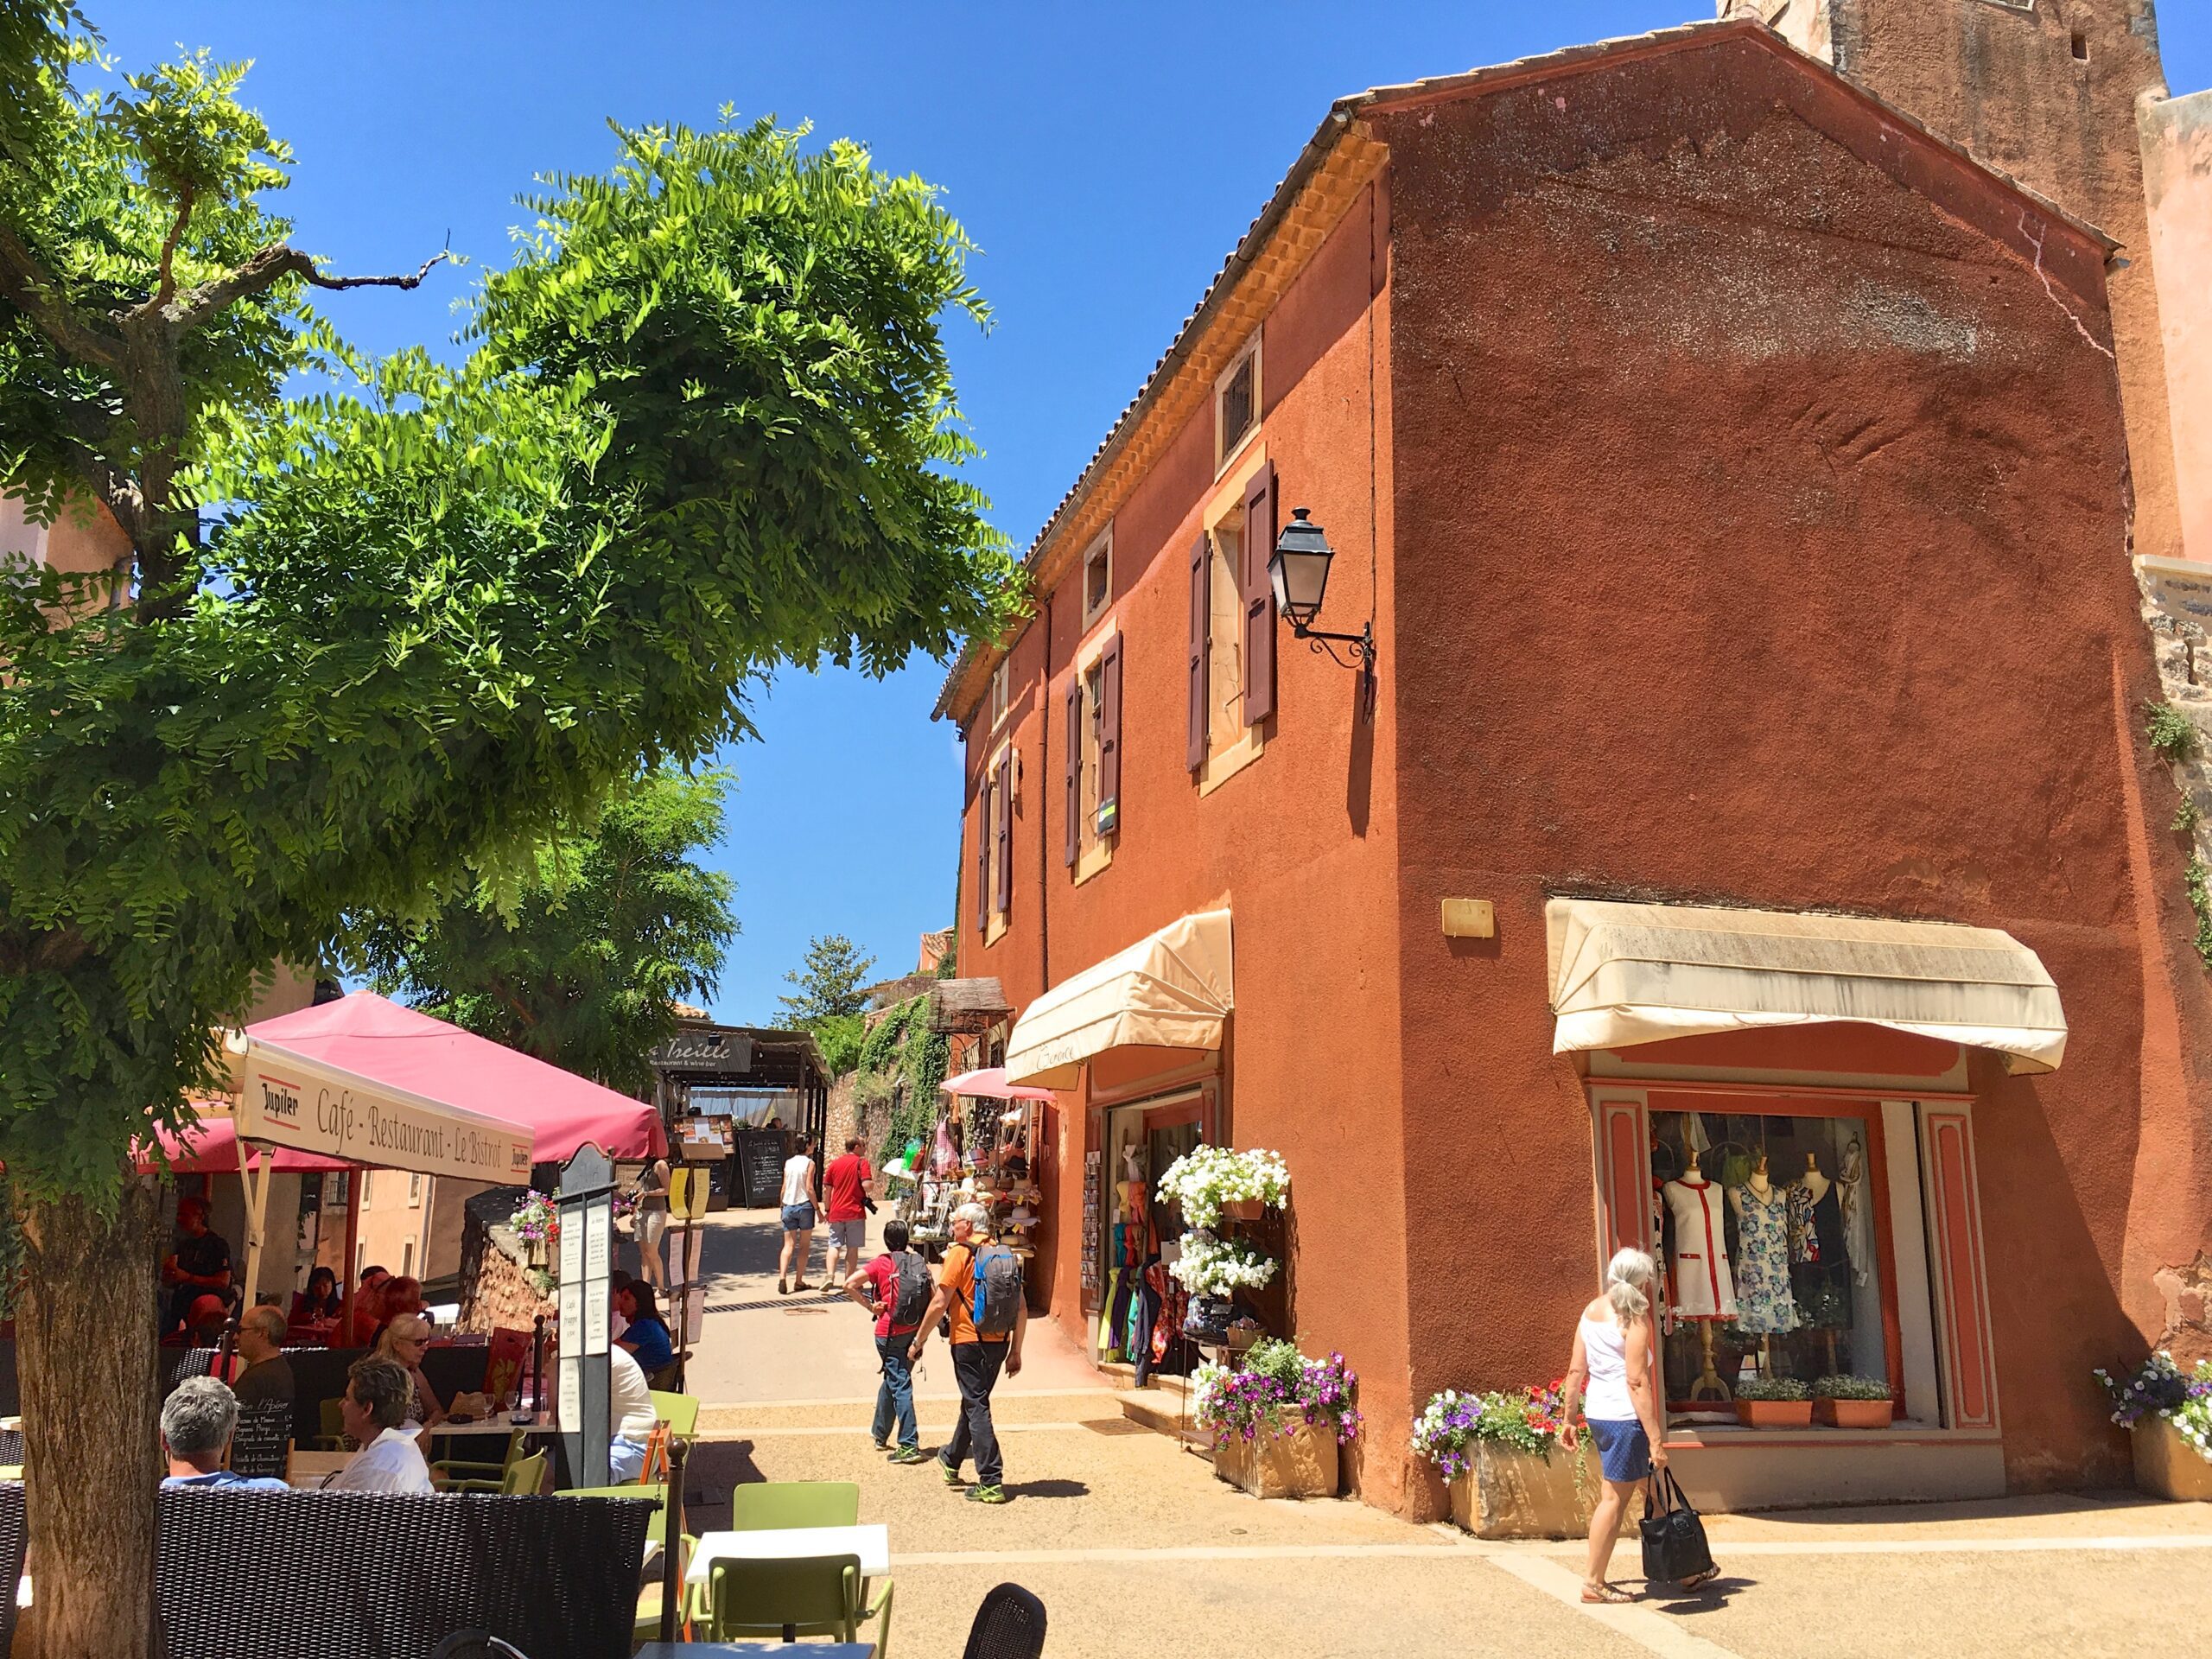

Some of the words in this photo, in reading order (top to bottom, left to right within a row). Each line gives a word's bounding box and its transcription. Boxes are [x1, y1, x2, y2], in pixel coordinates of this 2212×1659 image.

[667, 1037, 730, 1059] Treille
[261, 1082, 299, 1119] Jupiler
[317, 1088, 354, 1154] Café
[368, 1105, 445, 1160] Restaurant
[454, 1127, 467, 1163] Le
[468, 1131, 502, 1169] Bistrot
[511, 1147, 529, 1168] Jupiler
